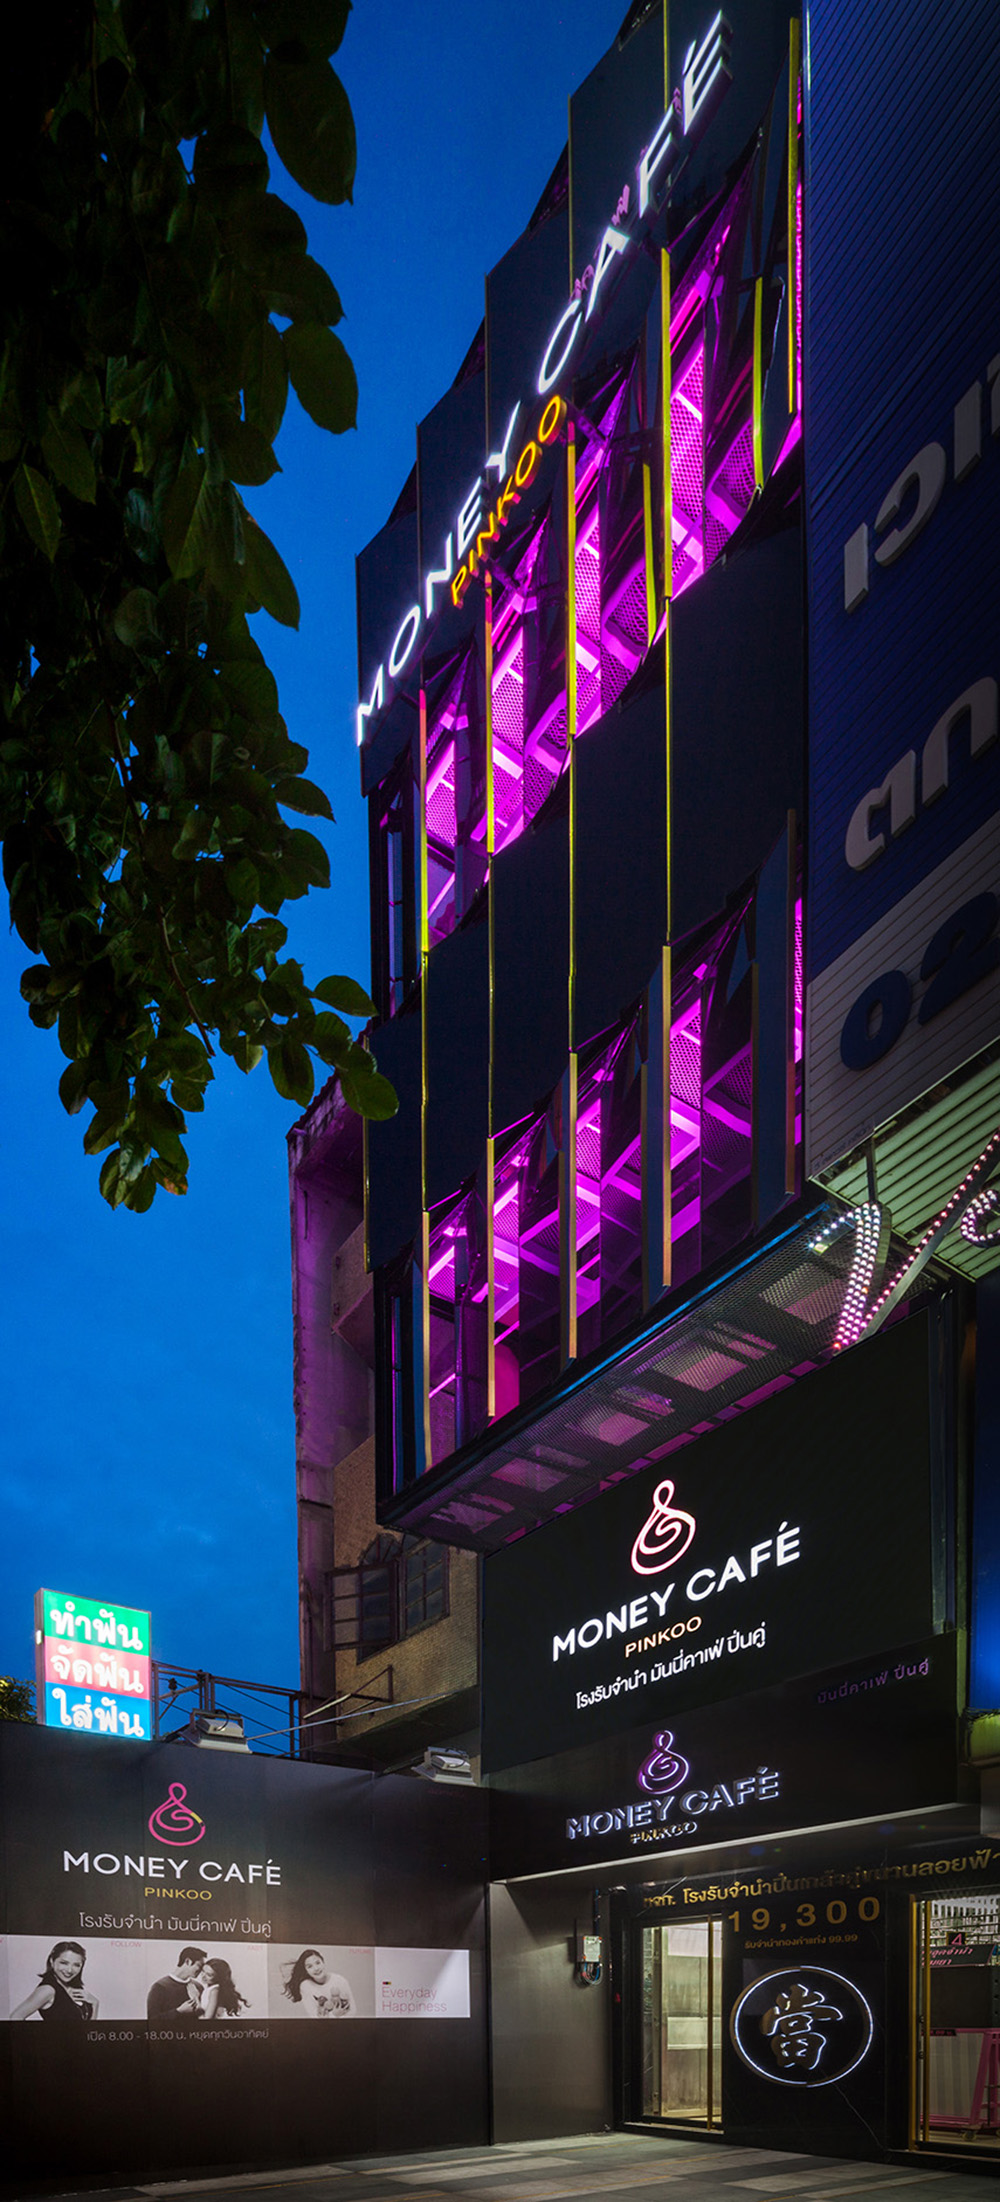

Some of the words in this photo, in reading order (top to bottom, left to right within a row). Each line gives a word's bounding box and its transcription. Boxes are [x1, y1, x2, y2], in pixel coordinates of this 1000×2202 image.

[357, 400, 521, 748] MONEY
[537, 8, 732, 395] CAFÉ
[450, 394, 567, 608] PINKOO
[552, 1582, 676, 1662] MONEY
[685, 1520, 801, 1602] CAFÉ
[49, 1600, 144, 1651] ทำฟัน
[624, 1615, 703, 1659] PINKOO
[50, 1643, 145, 1695] จัดฟัน
[576, 1669, 648, 1710] โรงรับจำนำ
[650, 1637, 726, 1683] มันนี่คาเฟ่
[726, 1621, 767, 1654] ปิ่นคู่
[51, 1687, 145, 1738] ใส่ฟัน
[565, 1795, 676, 1840] MONEY
[678, 1766, 780, 1816] CAFÉ
[629, 1821, 698, 1845] PINKOO
[62, 1850, 190, 1880] MONEY
[198, 1858, 283, 1886] CAFÉ
[144, 1886, 213, 1901] PINKOO
[78, 1911, 164, 1930] โรงรับจำนำ
[167, 1914, 238, 1933] มันนี่คาเฟ่
[240, 1918, 272, 1939] ปิ่นคู่
[727, 1896, 881, 1933] 19,300
[110, 1940, 142, 1949] FOLLOW
[381, 1985, 438, 2001] Everyday
[381, 2000, 448, 2014] Happiness
[108, 2030, 134, 2042] 8.00
[145, 2030, 174, 2041] 18.00
